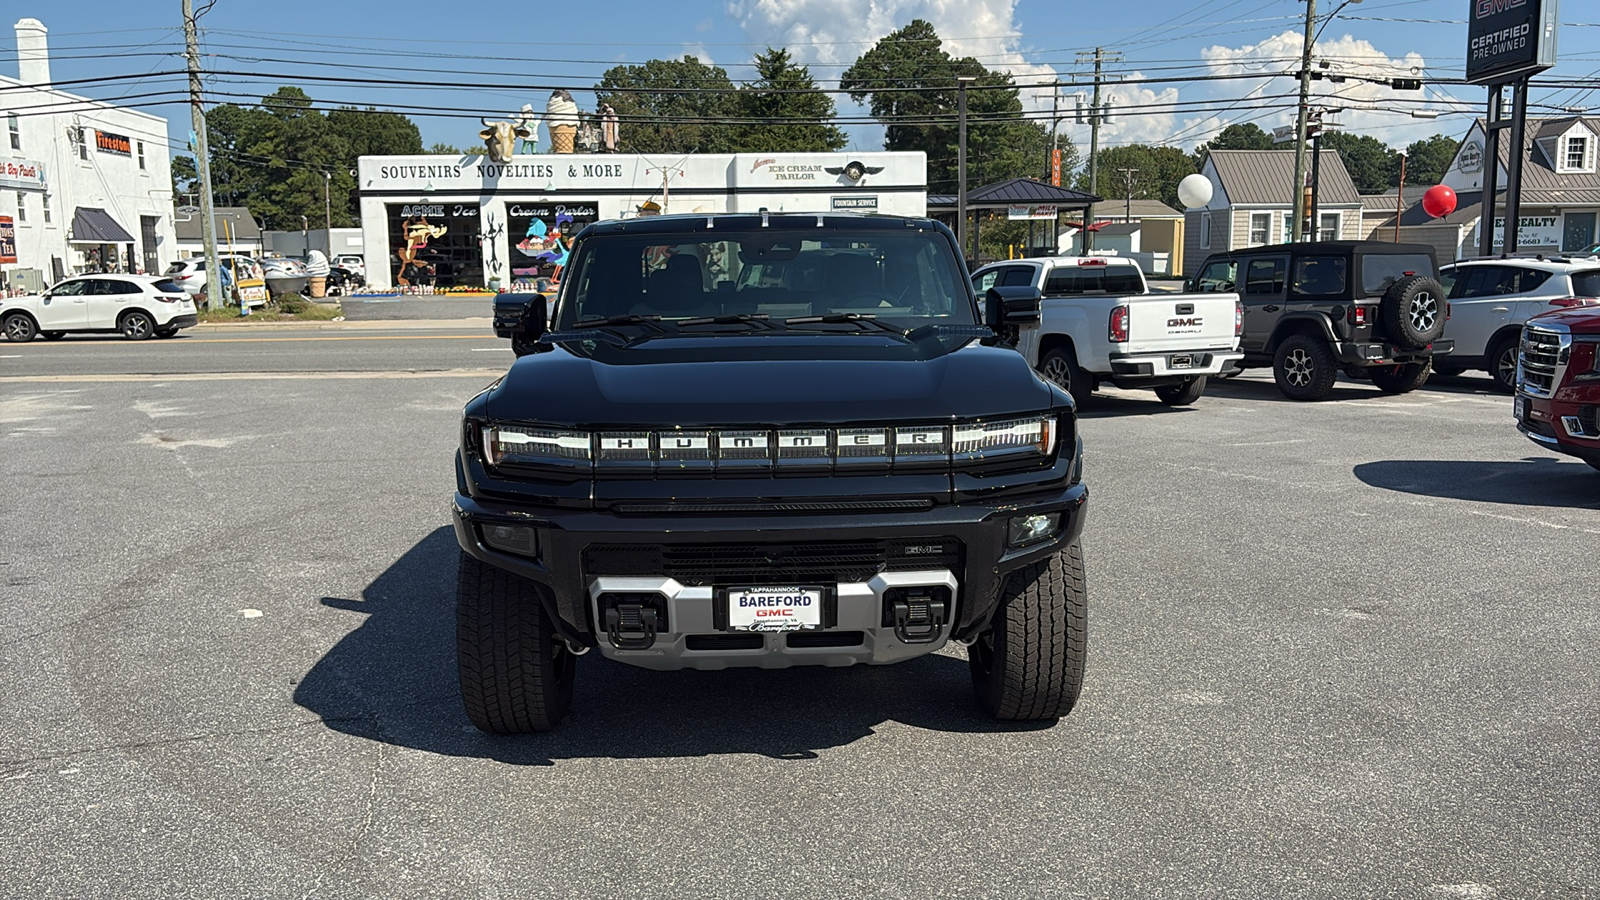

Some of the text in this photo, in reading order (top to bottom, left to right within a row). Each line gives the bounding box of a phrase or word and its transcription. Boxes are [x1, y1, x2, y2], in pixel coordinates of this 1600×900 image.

[1471, 23, 1530, 49] CERTIFIED
[1473, 37, 1526, 60] PRE-OWNED
[95, 131, 130, 152] Firestone
[7, 163, 19, 179] Boy
[19, 164, 36, 178] Paints
[381, 165, 622, 179] SOUVENIRS NOVELTIES & MORE
[768, 165, 785, 173] ICE
[834, 199, 857, 207] FOUNTAIN
[401, 204, 478, 217] ACME Ice
[509, 205, 597, 217] Cream Parlor
[2, 243, 14, 255] TEA
[1167, 318, 1203, 327] GMC
[617, 433, 928, 448] HUMMER
[905, 546, 943, 555] GMC
[739, 596, 812, 607] BAREFORD
[756, 609, 793, 617] GMC
[748, 622, 804, 634] Bareford
